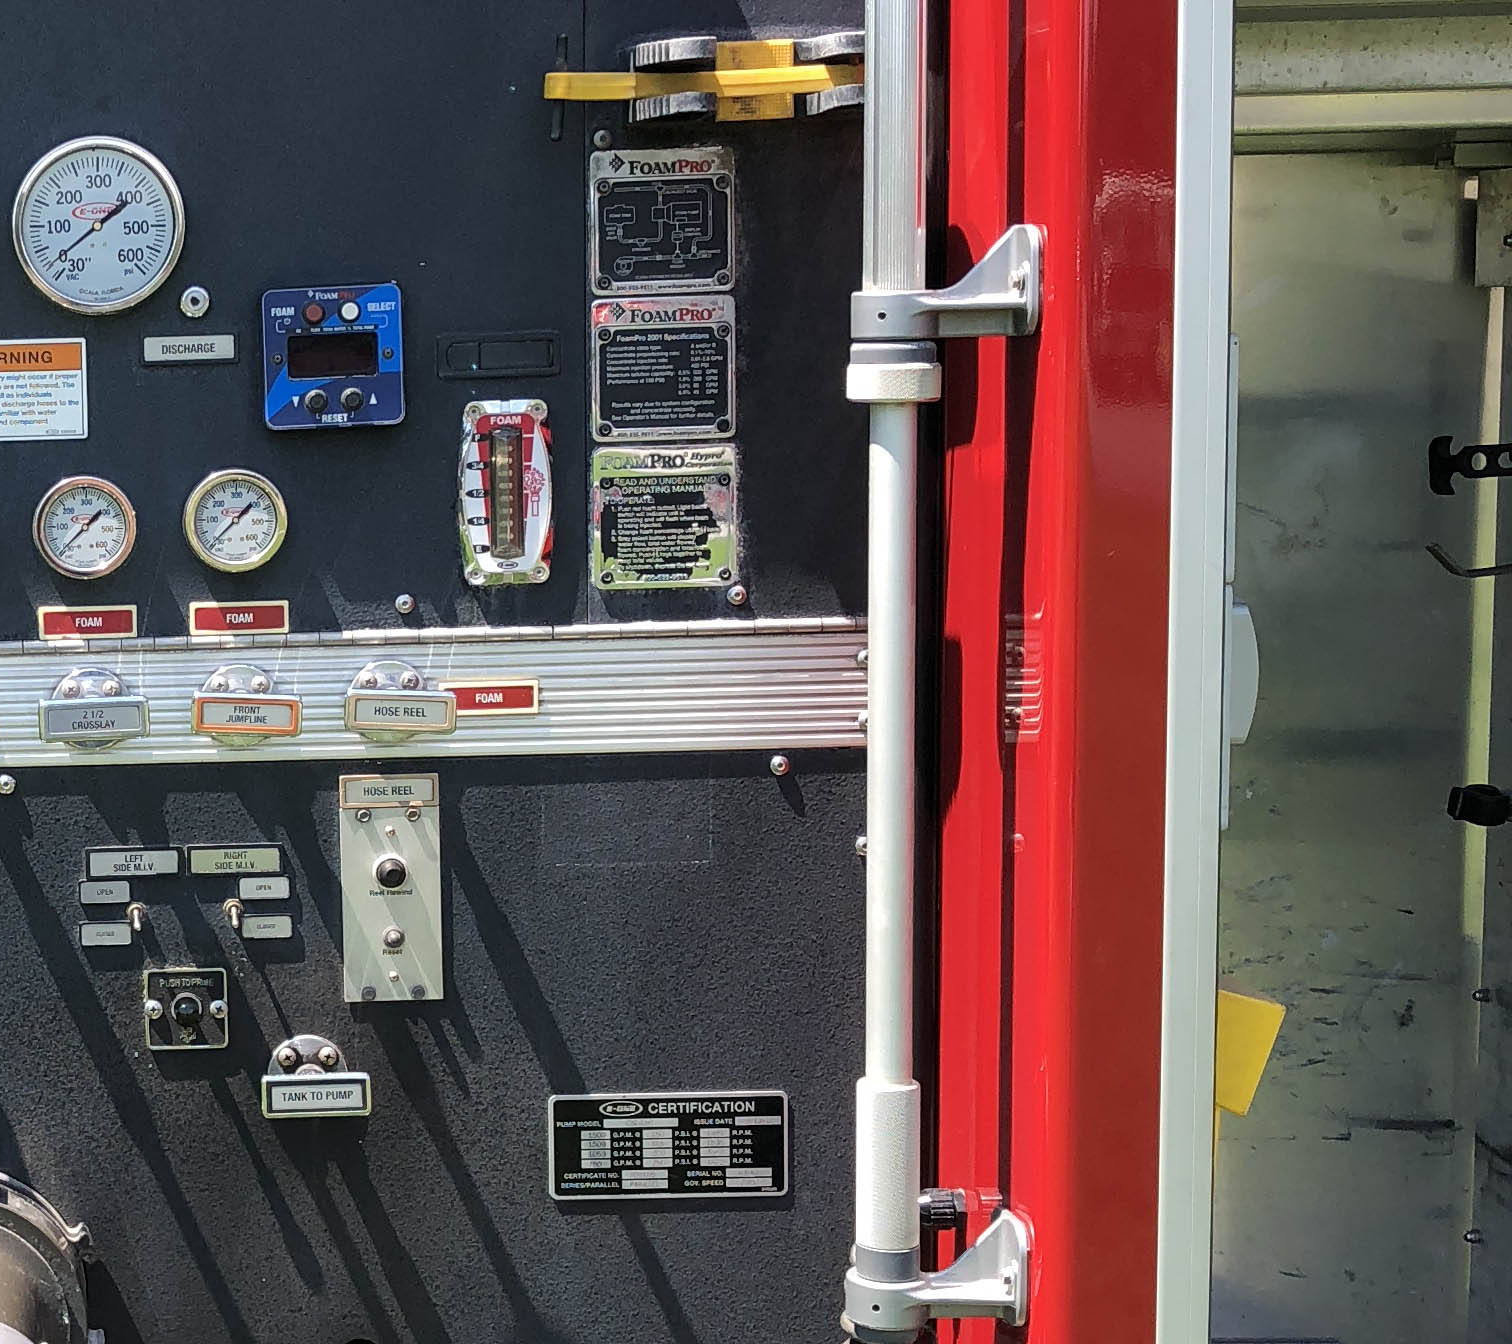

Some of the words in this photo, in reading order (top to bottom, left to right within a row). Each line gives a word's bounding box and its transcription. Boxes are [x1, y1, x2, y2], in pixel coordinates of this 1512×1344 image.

[85, 174, 112, 189] 300
[55, 190, 82, 205] 200
[116, 190, 142, 204] 400
[47, 219, 71, 234] 100
[123, 220, 149, 235] 500
[58, 249, 67, 263] 0
[117, 248, 144, 263] 600
[123, 268, 134, 276] psi
[271, 307, 295, 317] FOAM
[367, 301, 396, 312] SELECT
[663, 333, 710, 341] Specifications
[161, 342, 216, 355] DISCHARGE
[322, 413, 348, 423] RESET
[490, 415, 522, 425] FOAM
[613, 478, 637, 486] READ
[638, 477, 657, 485] AND
[659, 476, 717, 484] UNDERSTAND
[621, 486, 671, 494] OPERATING
[672, 485, 706, 493] MANUAL
[75, 616, 103, 628] FOAM
[225, 612, 254, 624] FOAM
[475, 692, 503, 704] FOAM
[82, 710, 89, 719] 2
[90, 710, 105, 719] 1/2
[233, 706, 261, 715] FRONT
[374, 706, 400, 717] HOSE
[402, 706, 427, 717] REEL
[71, 719, 116, 730] CROSSLAY
[363, 786, 389, 797] HOSE
[391, 785, 415, 796] REEL
[124, 854, 144, 863] LEFT
[223, 851, 248, 860] RIGHT
[113, 863, 132, 872] SIDE
[214, 861, 234, 870] SIDE
[382, 948, 403, 956] Reset
[159, 978, 181, 988] PUSH
[181, 978, 191, 987] TO
[281, 1092, 307, 1102] TANK
[310, 1091, 323, 1101] TO
[325, 1090, 354, 1100] PUMP
[648, 1101, 755, 1114] CERTIFICATION
